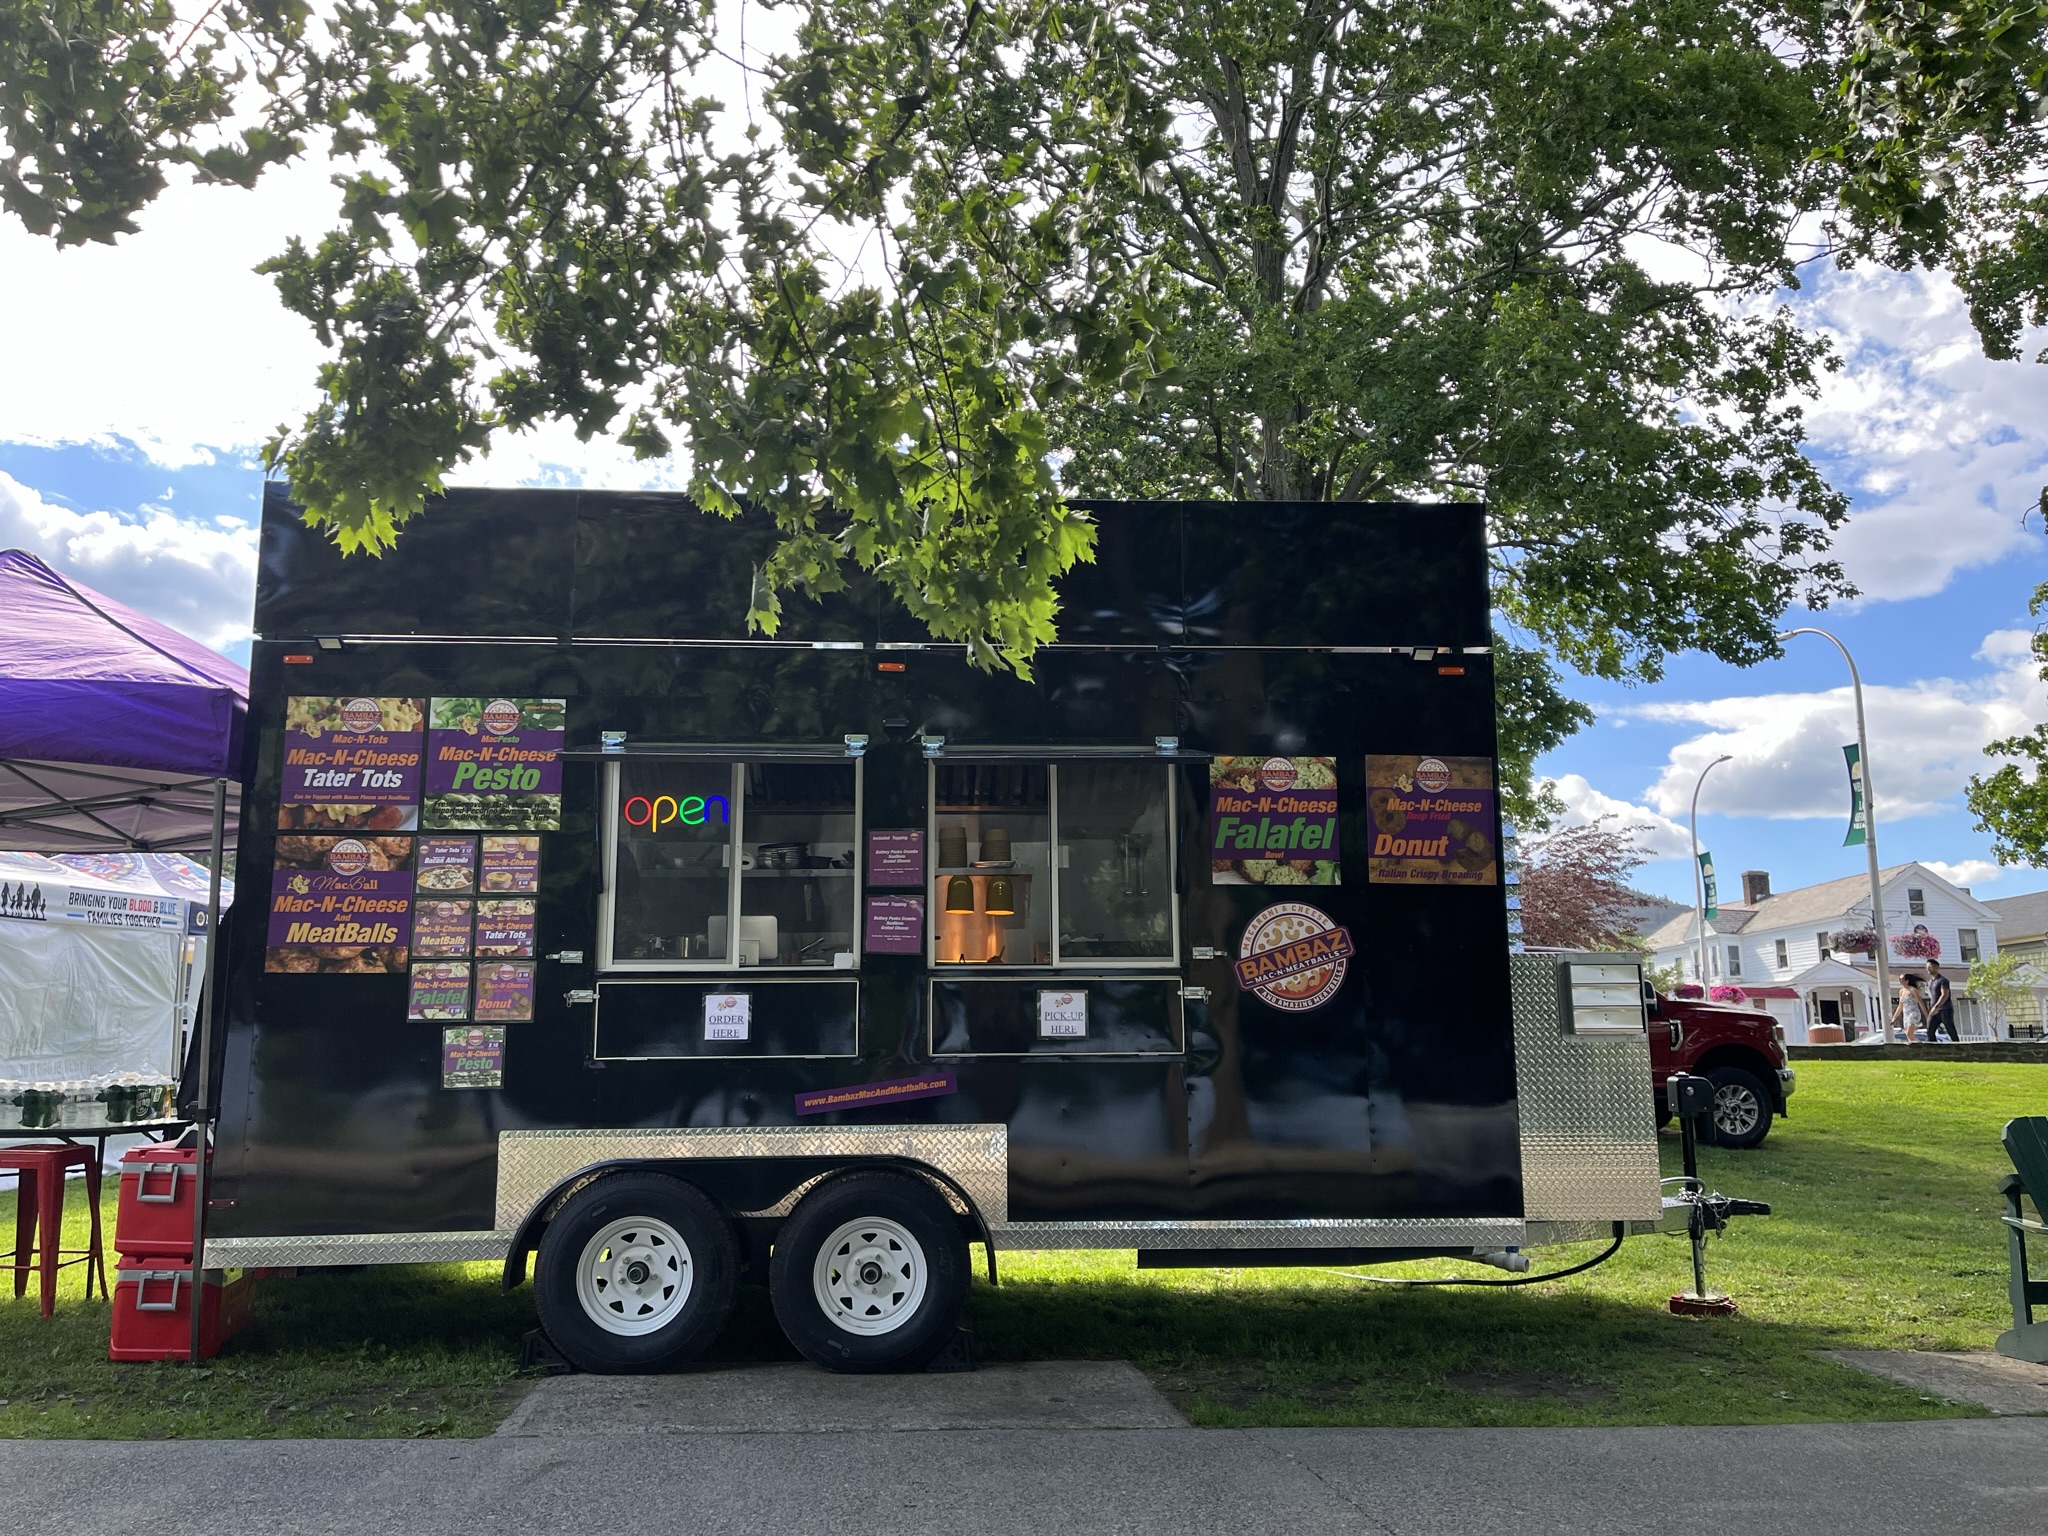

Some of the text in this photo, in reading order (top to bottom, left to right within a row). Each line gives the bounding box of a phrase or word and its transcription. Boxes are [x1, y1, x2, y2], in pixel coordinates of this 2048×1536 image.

[332, 735, 388, 744] Mac-N-Tots
[481, 735, 520, 743] MacPesto
[287, 749, 419, 766] Mac-N-Cheese
[439, 746, 557, 762] Mac-N-Cheese
[304, 768, 403, 788] Tater Tots
[451, 762, 541, 790] Pesto
[1216, 796, 1338, 813] Mac-N-Cheese
[1386, 798, 1482, 812] Mac-N-Cheese
[624, 795, 729, 833] open
[1406, 812, 1451, 821] Deep Fried
[1214, 816, 1336, 850] Falafel
[1374, 834, 1450, 856] Donut
[1378, 868, 1483, 880] Italian Crispy Breading
[68, 892, 177, 915] BRINGING YOUR BLOOD & BLUE
[273, 895, 408, 913] Mac-N-Cheese
[87, 911, 161, 928] FAMILIES TOGETHER
[334, 914, 352, 922] And
[286, 922, 398, 944] MeatBalls
[415, 925, 470, 933] Mac-N-Cheese
[478, 922, 533, 930] Mac-N-Cheese
[1242, 907, 1279, 951] MACARONI
[1291, 905, 1329, 926] CHEESE
[421, 936, 466, 945] MeatBalls
[485, 931, 527, 939] Tater Tots
[1240, 931, 1348, 980] BAMBAZ
[413, 981, 469, 990] Mac-N-Cheese
[1262, 966, 1343, 1008] AND AMAZING MEATBALLS
[412, 989, 468, 1005] Falafel
[478, 999, 512, 1009] Donut
[709, 1016, 744, 1024] ORDER
[1044, 1012, 1084, 1020] PICK-UP
[713, 1029, 740, 1038] HERE
[1051, 1026, 1077, 1034] HERE
[450, 1050, 500, 1058] Mac-N-Cheese
[456, 1057, 494, 1070] Pesto
[804, 1079, 947, 1107] www.BambazMacAndMeatballs.com
